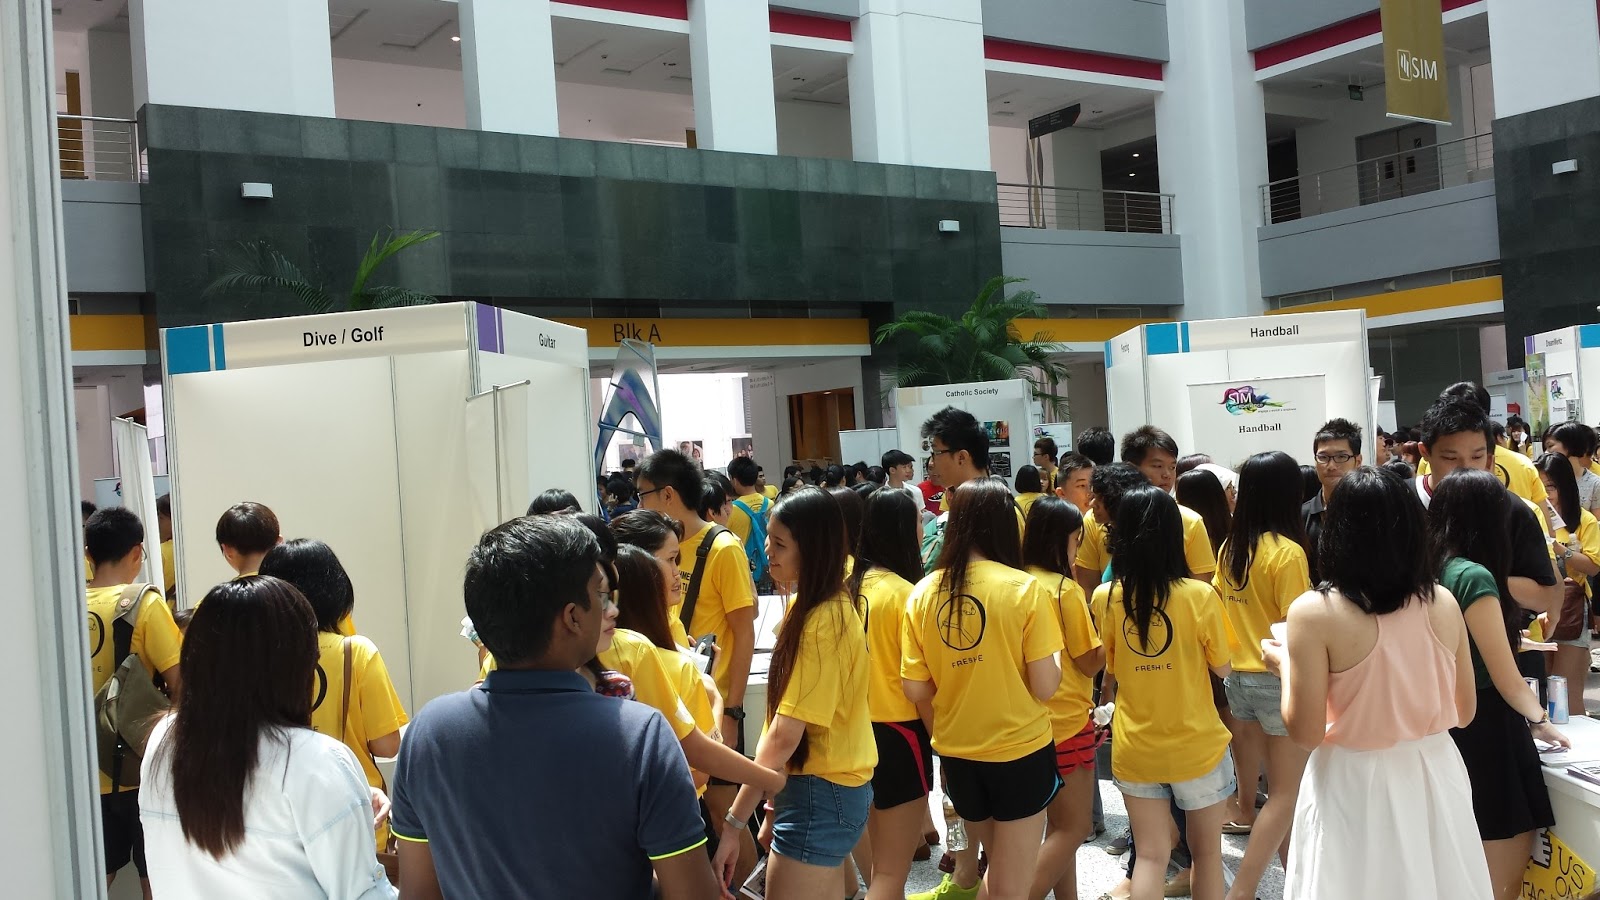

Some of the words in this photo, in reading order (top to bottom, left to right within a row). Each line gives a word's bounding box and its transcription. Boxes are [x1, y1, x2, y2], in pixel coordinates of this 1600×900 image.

[1411, 56, 1438, 81] SIM
[303, 331, 337, 347] Dive
[341, 328, 346, 344] /
[351, 326, 384, 343] Golf
[613, 323, 642, 343] Blk
[648, 323, 662, 342] A
[1250, 325, 1300, 338] Handball
[538, 333, 556, 349] Guitar
[945, 389, 973, 398] Catholic
[973, 387, 999, 395] Society
[1228, 392, 1252, 404] SIM
[1238, 423, 1282, 434] Handball
[1557, 846, 1586, 890] US
